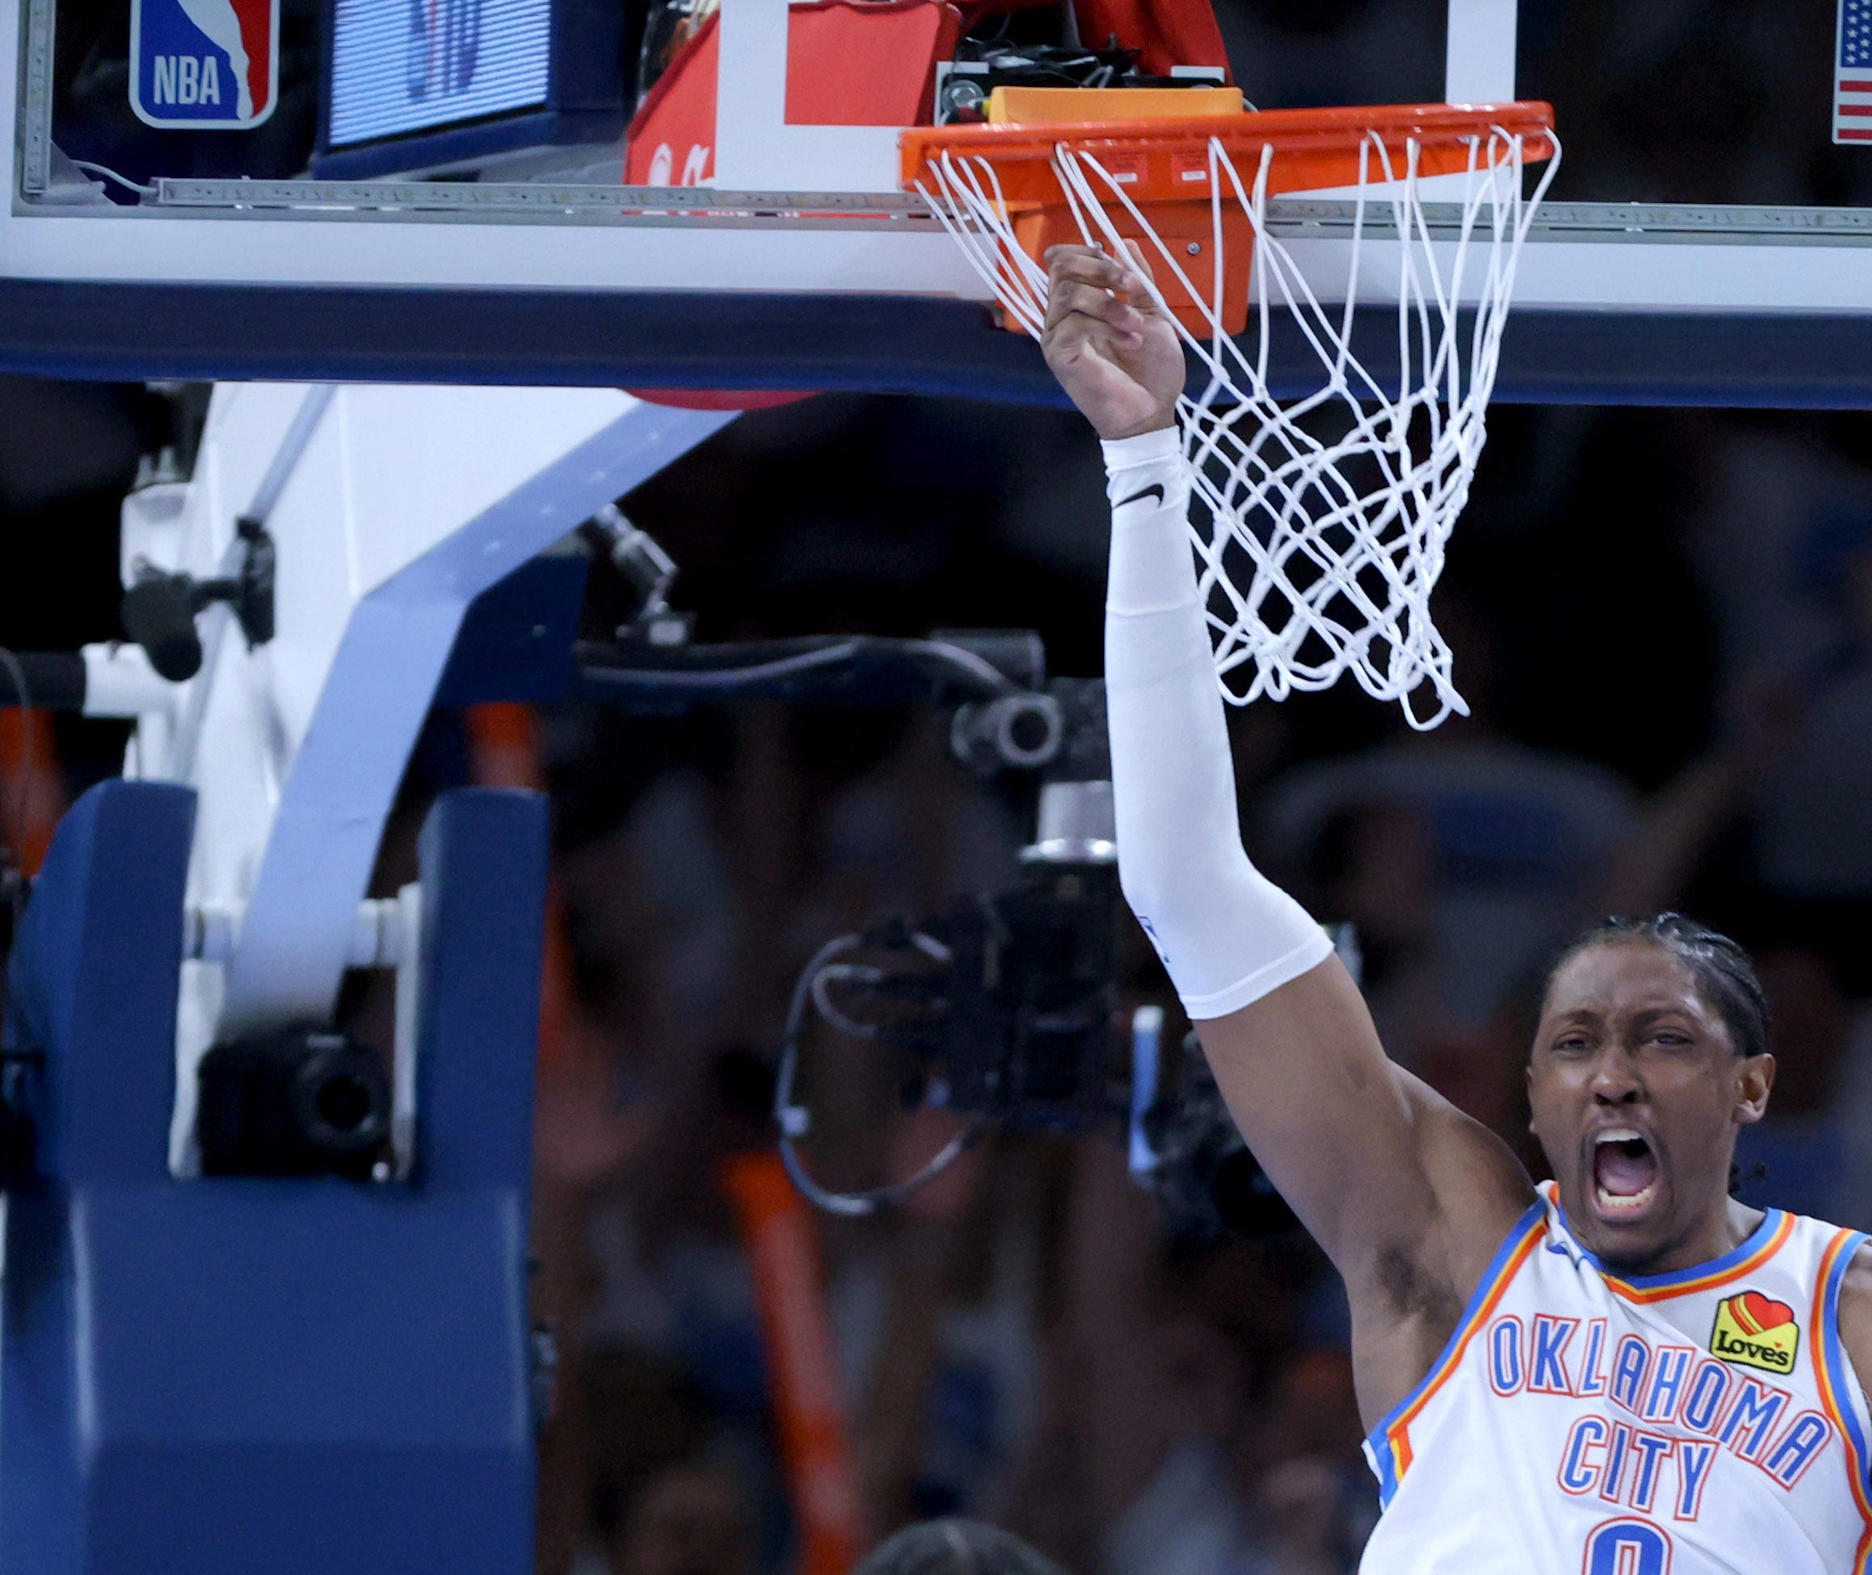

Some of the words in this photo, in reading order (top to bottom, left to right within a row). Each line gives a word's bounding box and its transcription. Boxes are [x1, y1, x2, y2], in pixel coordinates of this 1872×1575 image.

[153, 55, 221, 105] NBA
[1487, 1313, 1833, 1491] OKLAHOMA
[1557, 1414, 1720, 1522] CITY
